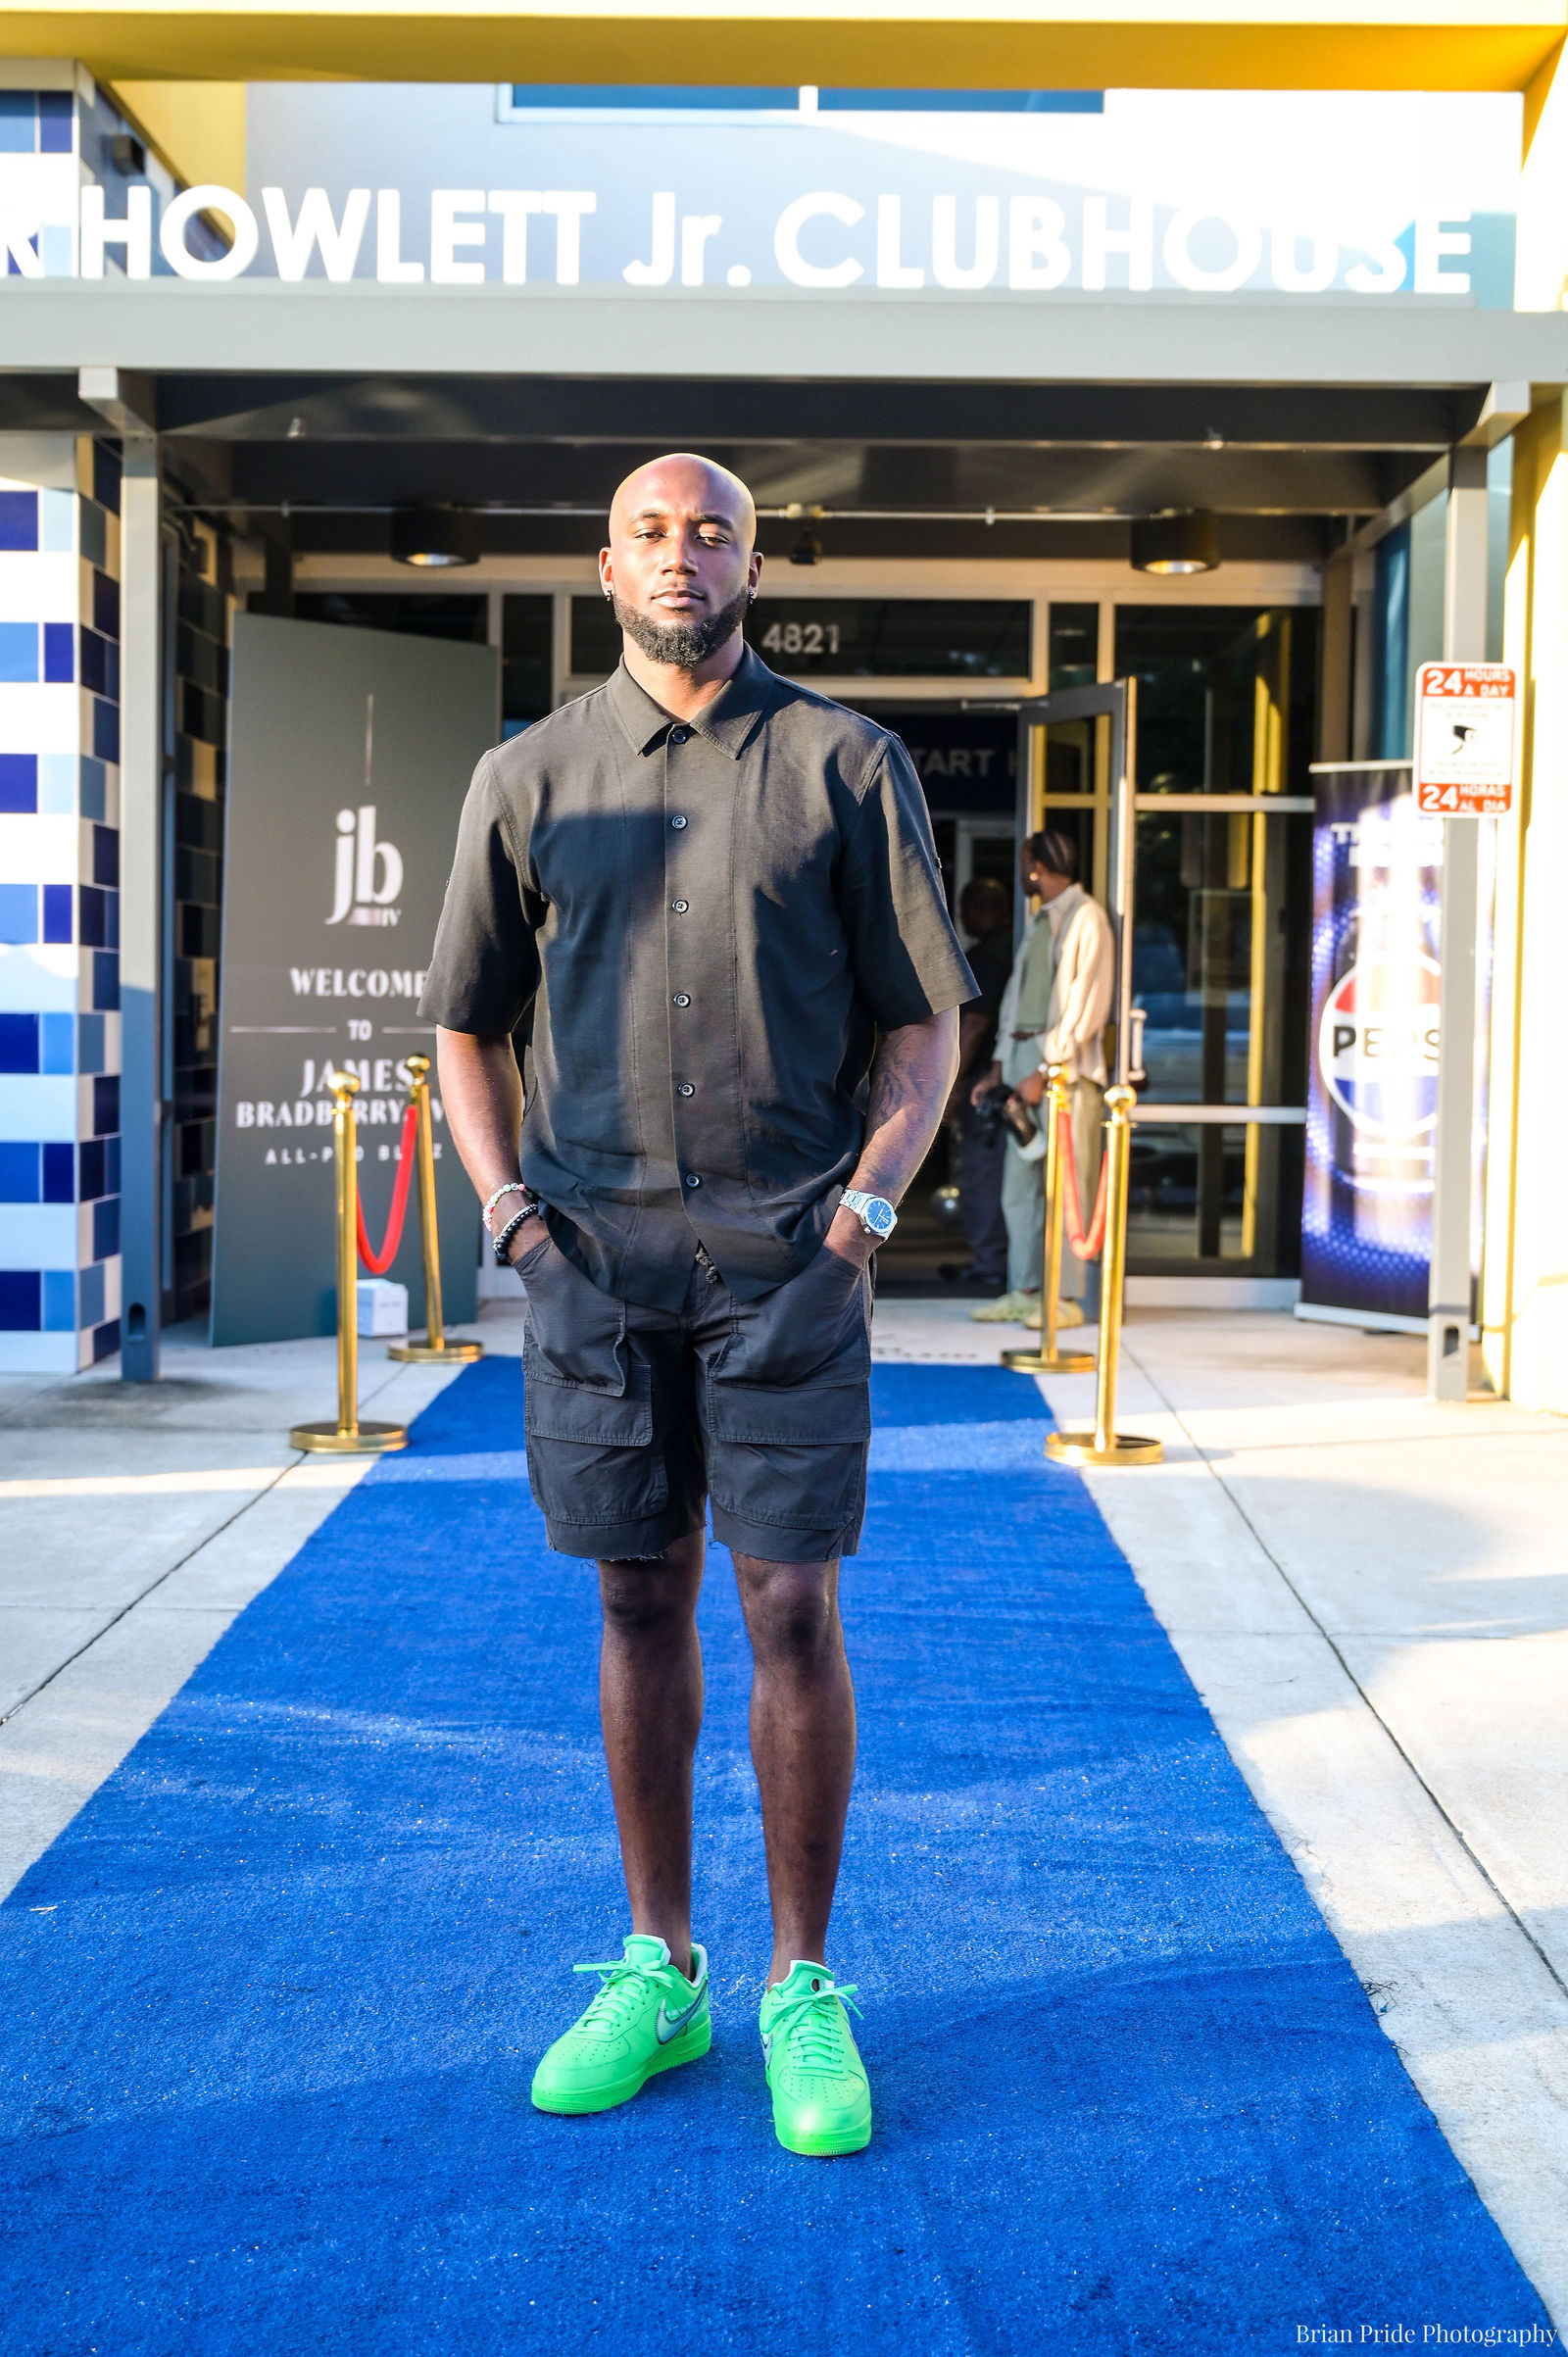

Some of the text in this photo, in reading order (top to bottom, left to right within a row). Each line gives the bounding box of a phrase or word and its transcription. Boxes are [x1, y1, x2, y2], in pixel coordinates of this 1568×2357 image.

[80, 184, 597, 285] HOWLETT
[623, 191, 752, 287] Jr.
[774, 191, 1472, 294] CLUBHOUSE
[762, 622, 840, 655] 4821
[1426, 668, 1512, 696] 24 HOURS
[1463, 683, 1510, 698] A DAY
[909, 748, 997, 778] TART
[1422, 784, 1505, 810] 24 HORAS
[1458, 800, 1477, 812] AL
[325, 806, 404, 926] jb
[347, 1018, 372, 1042] TO
[236, 1098, 405, 1127] BRADBRRY
[265, 1146, 365, 1165] ALL-PO
